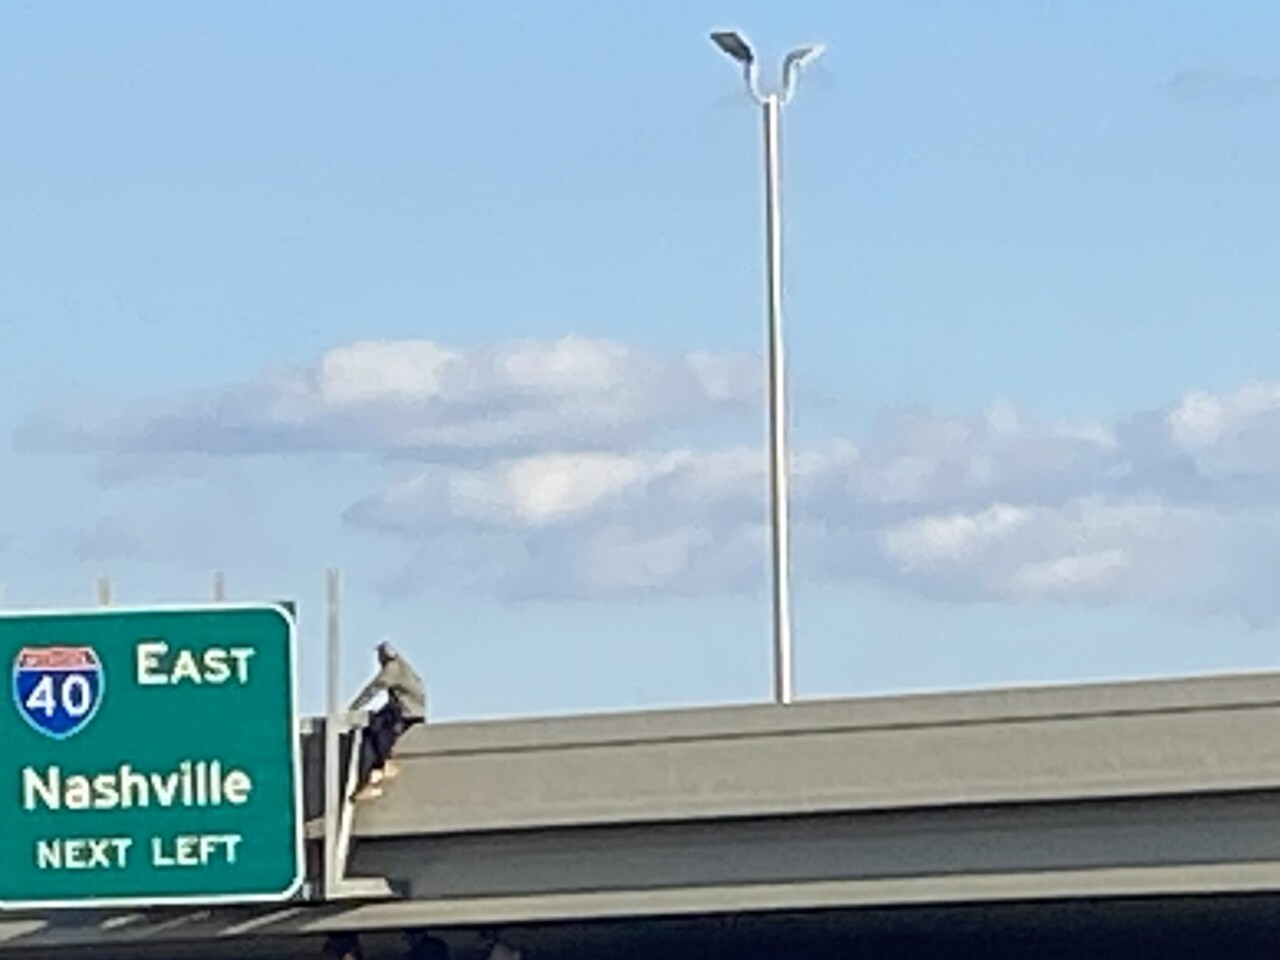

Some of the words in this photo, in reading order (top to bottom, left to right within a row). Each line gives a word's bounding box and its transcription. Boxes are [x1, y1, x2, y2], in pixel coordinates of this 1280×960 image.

[137, 641, 256, 684] EAST
[26, 674, 90, 717] 40
[22, 761, 251, 810] Nashville
[37, 838, 132, 869] NEXT
[151, 835, 242, 866] LEFT
